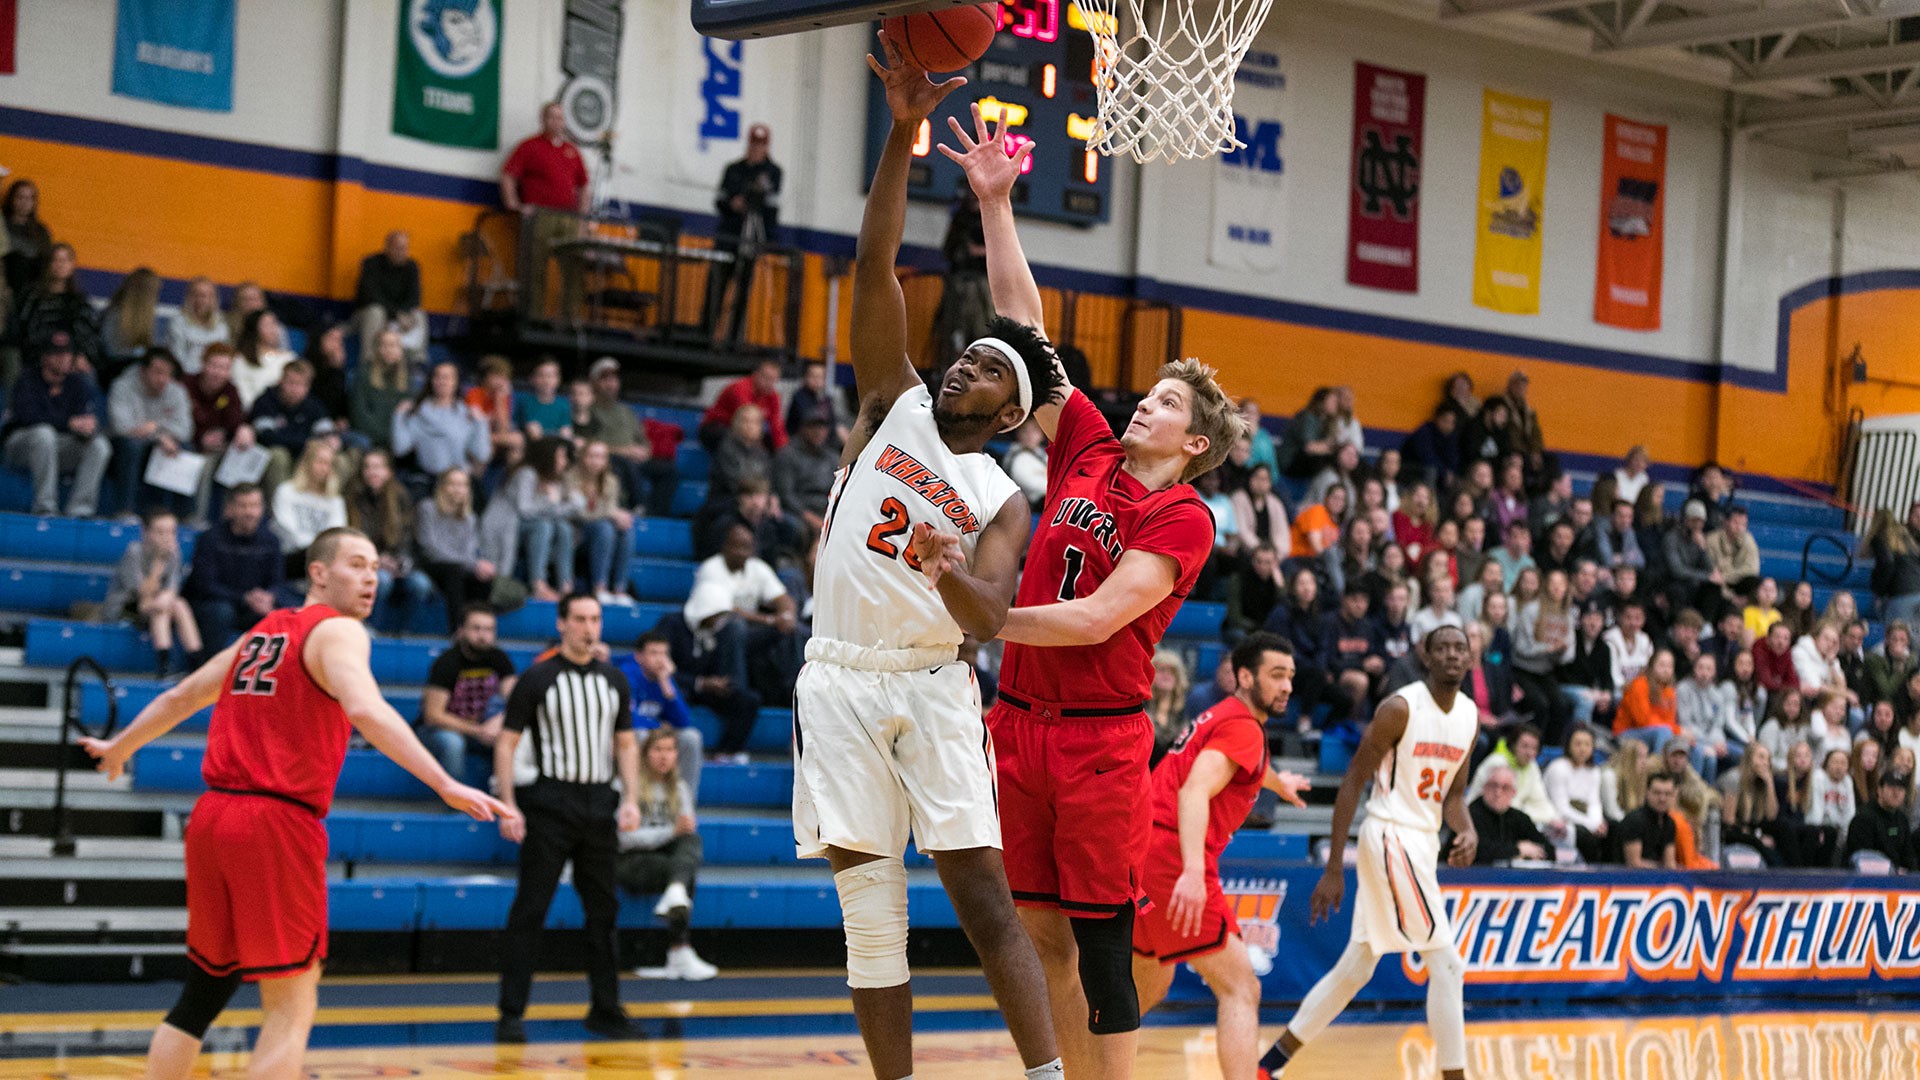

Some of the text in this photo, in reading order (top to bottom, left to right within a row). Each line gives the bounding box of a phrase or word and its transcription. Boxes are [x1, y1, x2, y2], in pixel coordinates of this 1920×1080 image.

[874, 444, 981, 535] WHEATON
[1056, 544, 1086, 602] 1
[229, 631, 289, 697] 22
